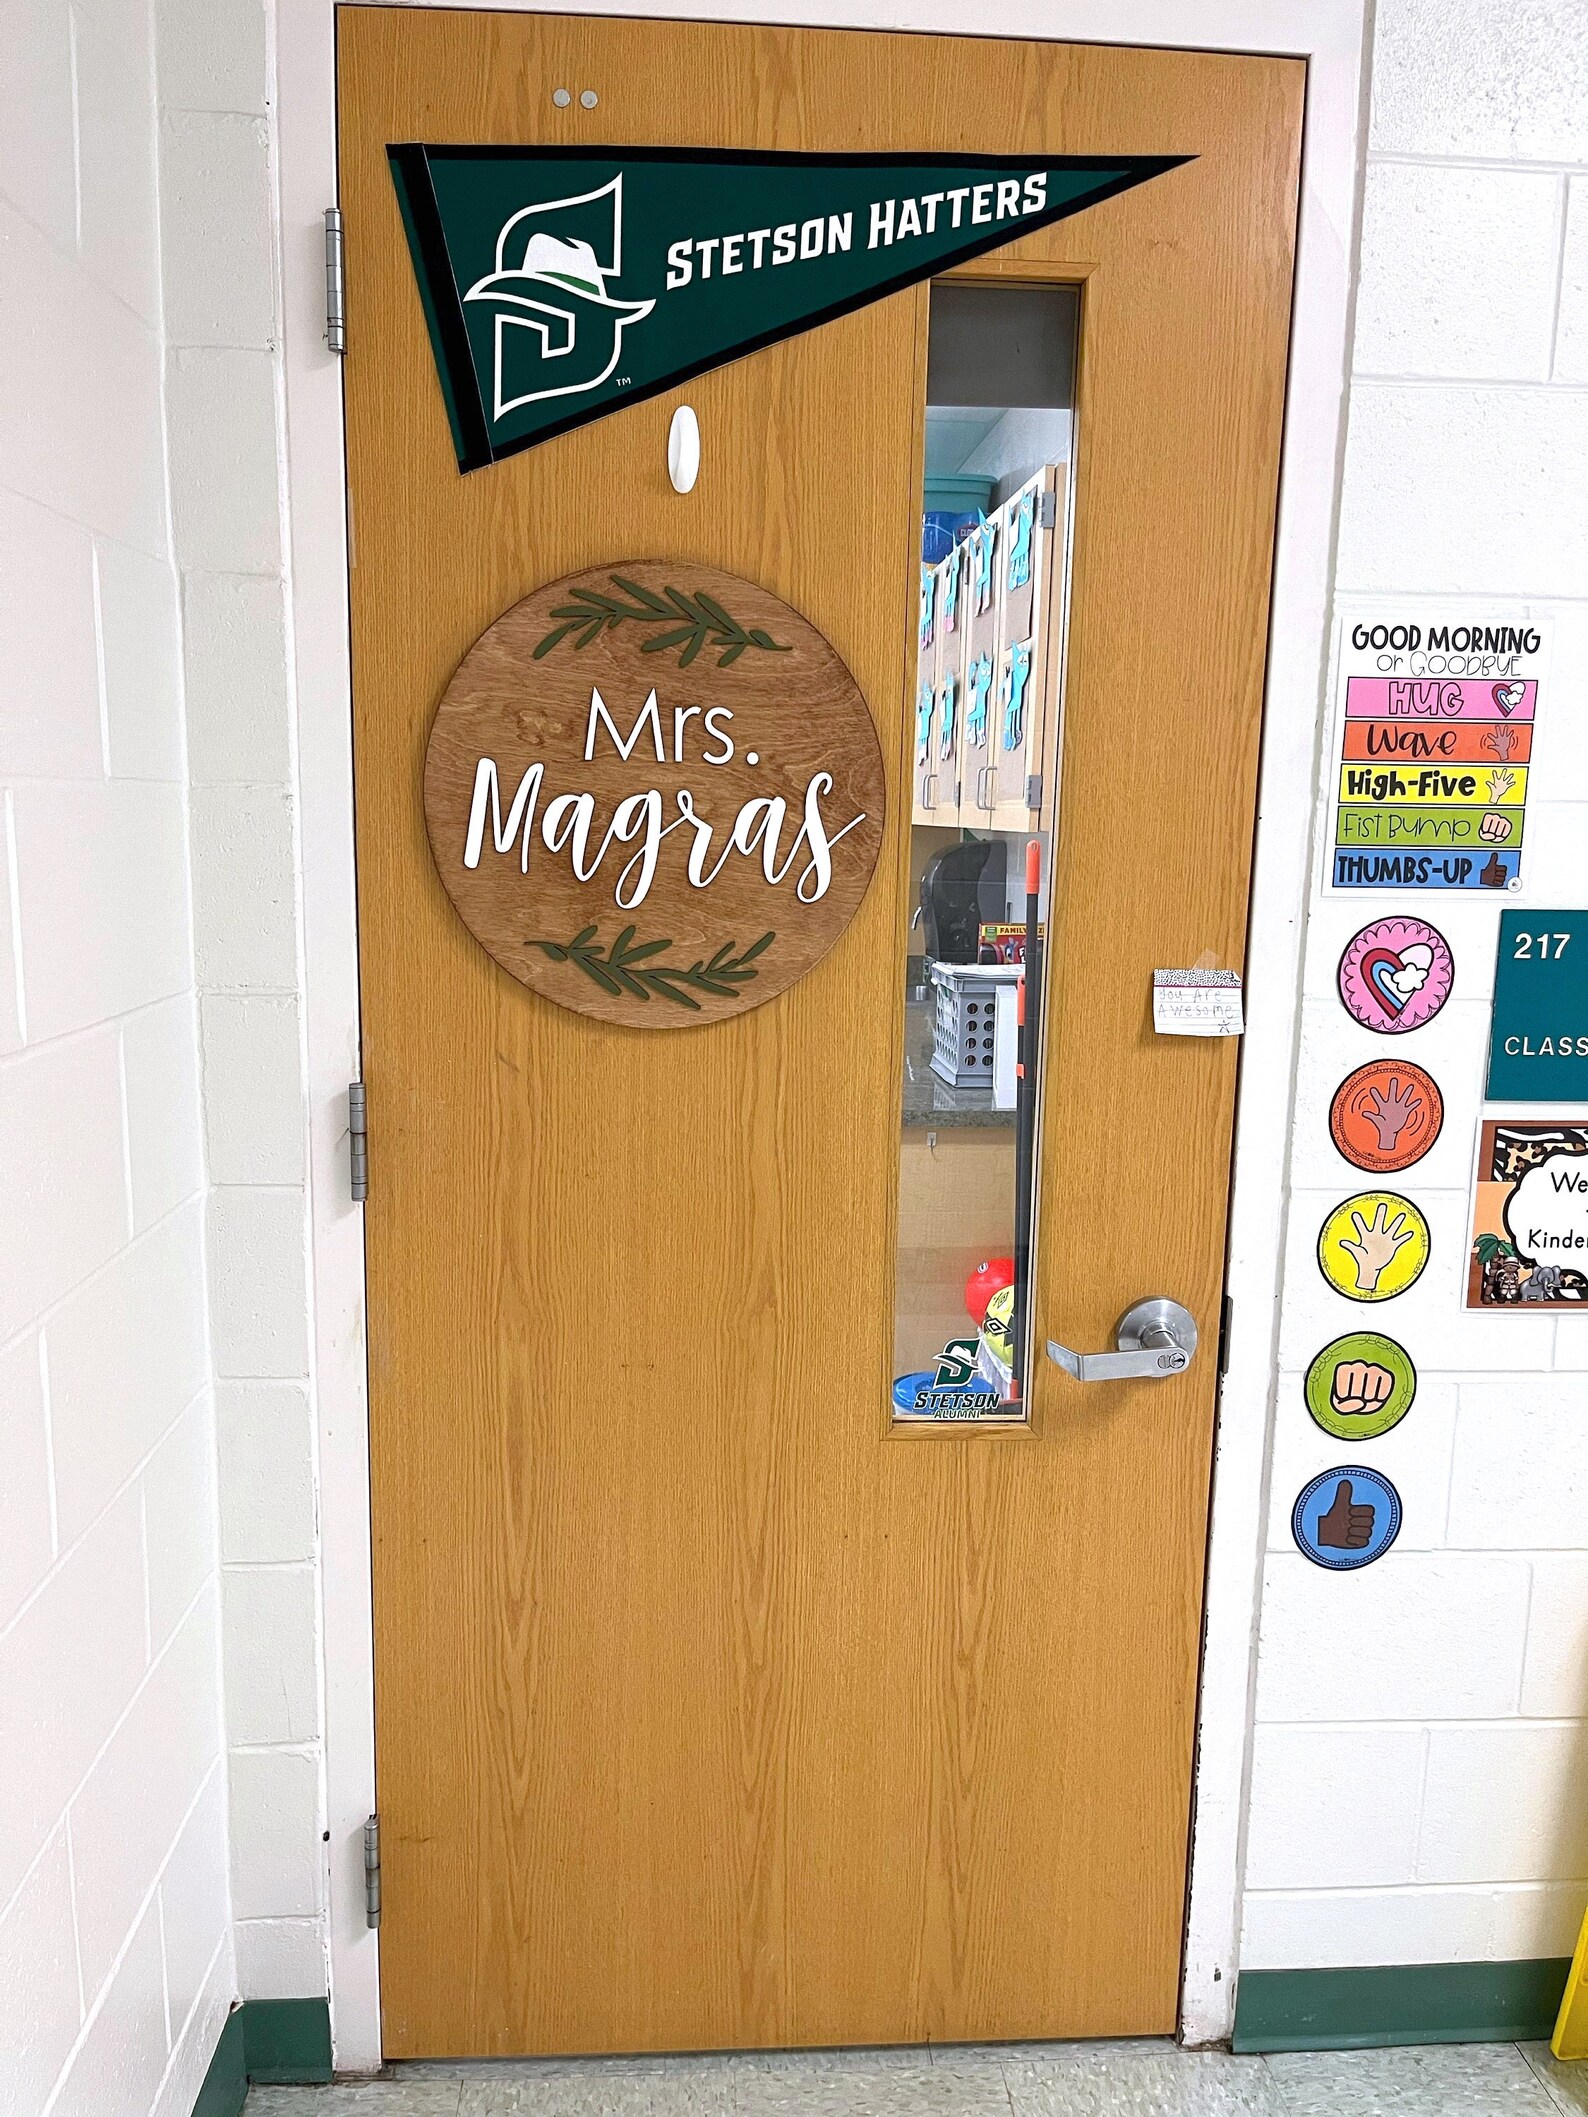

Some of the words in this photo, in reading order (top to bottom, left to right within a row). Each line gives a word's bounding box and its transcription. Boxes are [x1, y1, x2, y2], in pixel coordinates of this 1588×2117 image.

[666, 211, 853, 291] STETSON
[867, 171, 1048, 250] HATTERS
[615, 377, 632, 387] TM
[1352, 624, 1421, 651] GOOD
[1427, 626, 1541, 655] MORNING
[1410, 650, 1523, 677] GOODBYE
[1388, 681, 1465, 717] HUG
[584, 686, 760, 766] Mrs.
[1366, 724, 1458, 758] Wave
[1347, 768, 1477, 801] High-Five
[463, 757, 867, 910] Magras
[1343, 813, 1383, 838] Fist
[1389, 814, 1471, 842] Bump
[1338, 855, 1473, 884] THUMBS-UP
[1513, 932, 1571, 959] 217
[1504, 1036, 1588, 1056] CLASS
[1550, 1171, 1588, 1194] We
[1528, 1228, 1588, 1249] Kinde
[912, 1391, 1001, 1410] STETSON
[933, 1409, 981, 1419] ALUMNI
